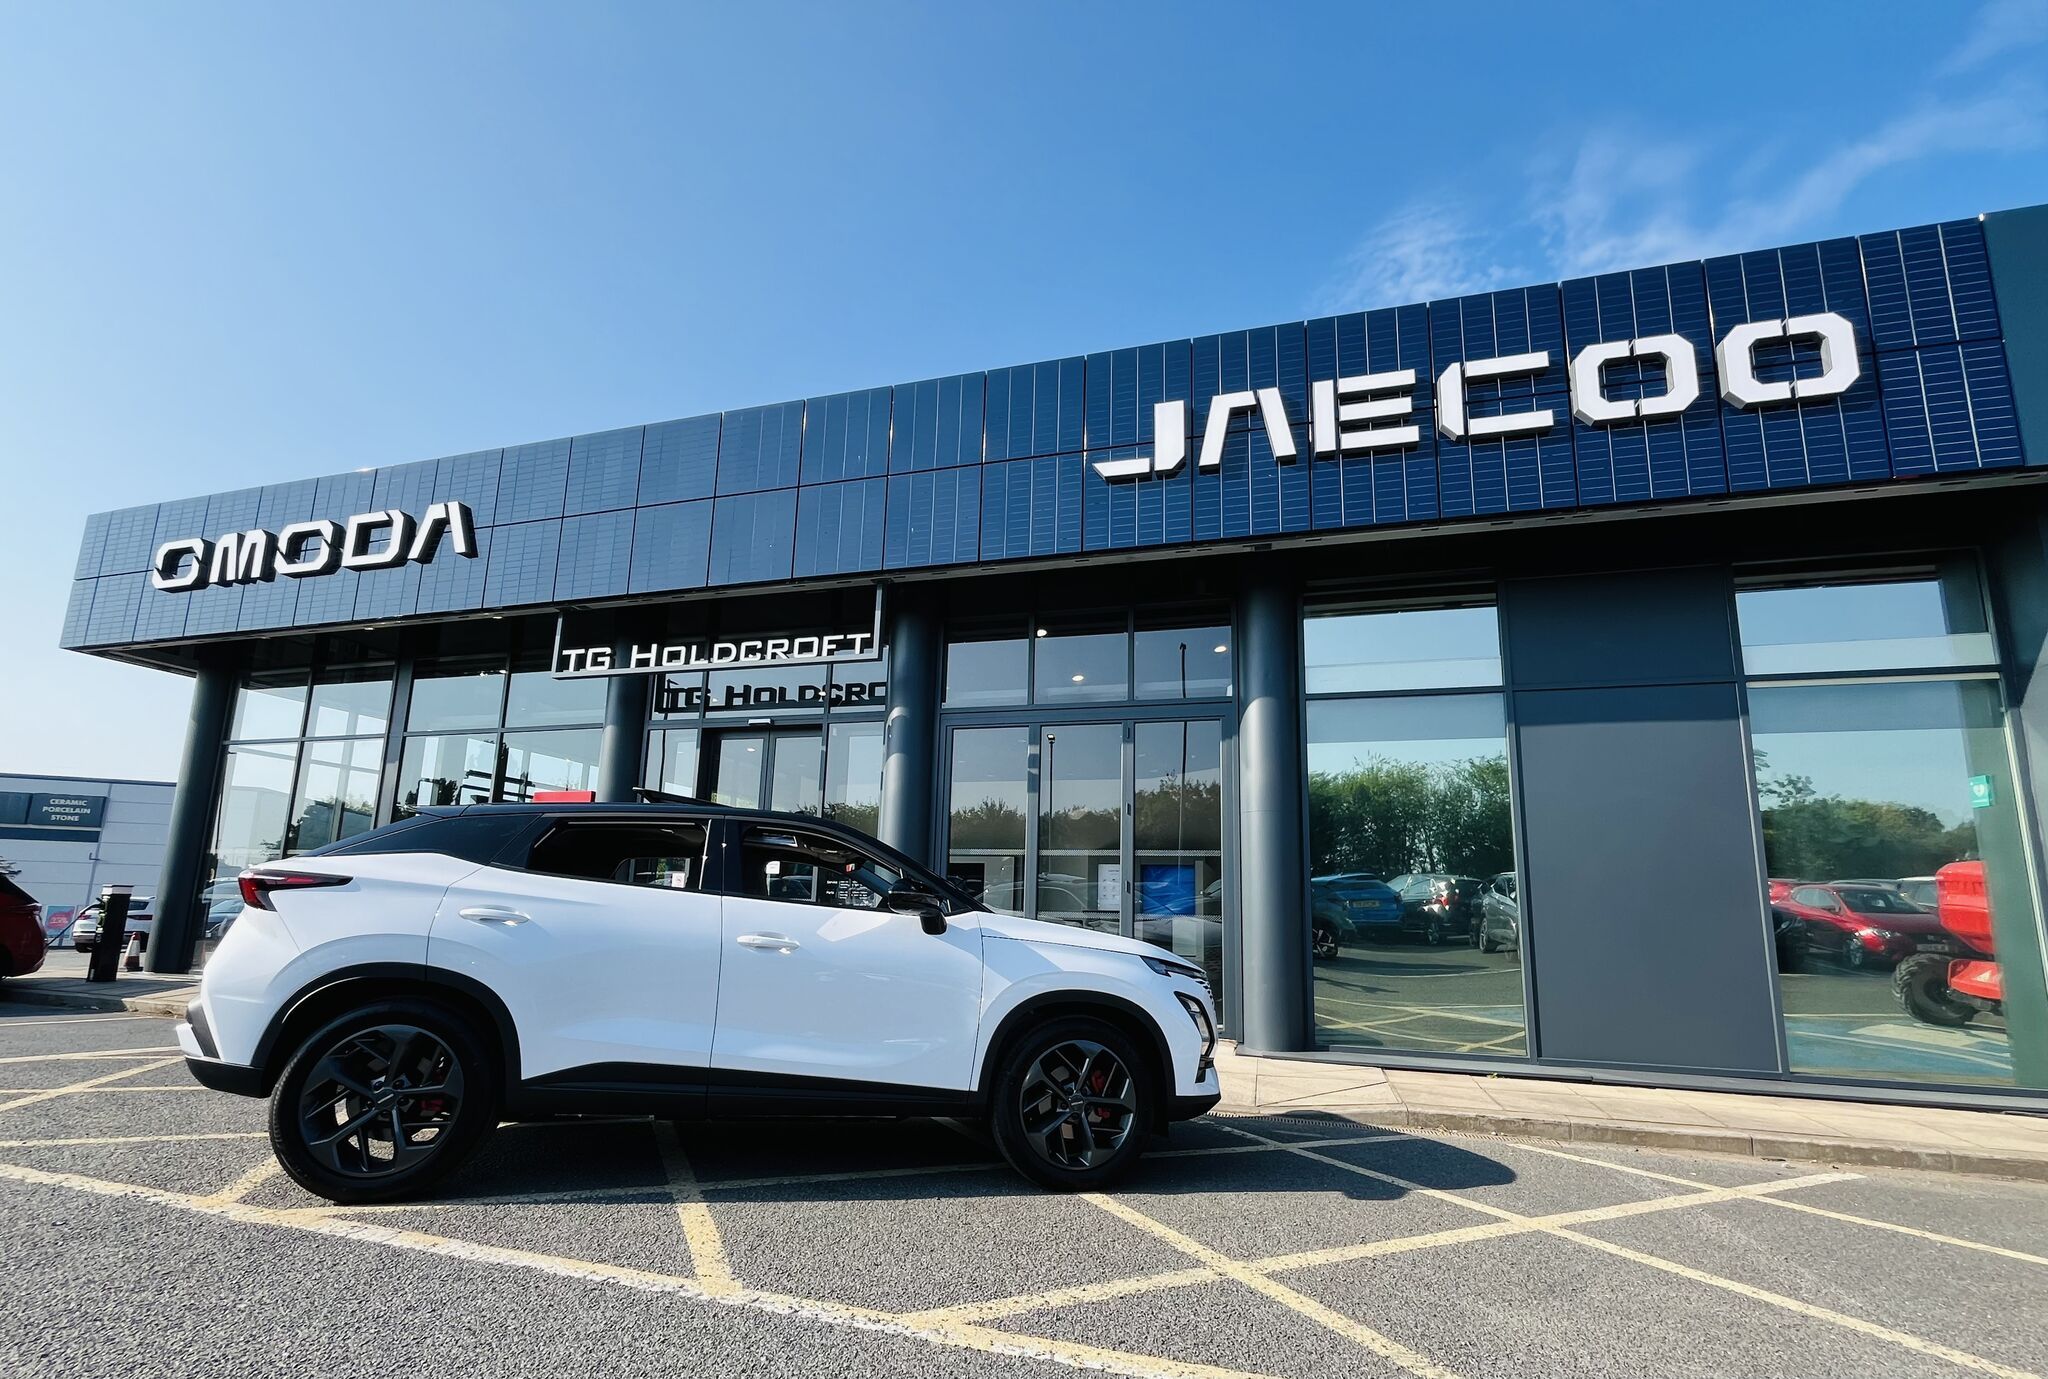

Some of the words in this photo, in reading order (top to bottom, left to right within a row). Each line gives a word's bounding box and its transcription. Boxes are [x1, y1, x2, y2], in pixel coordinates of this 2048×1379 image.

[1092, 311, 1861, 482] JAECOO
[152, 501, 476, 593] OMODA
[562, 647, 611, 672] TG
[630, 633, 871, 669] HOLDCROFT
[42, 806, 91, 814] PORCELAIN
